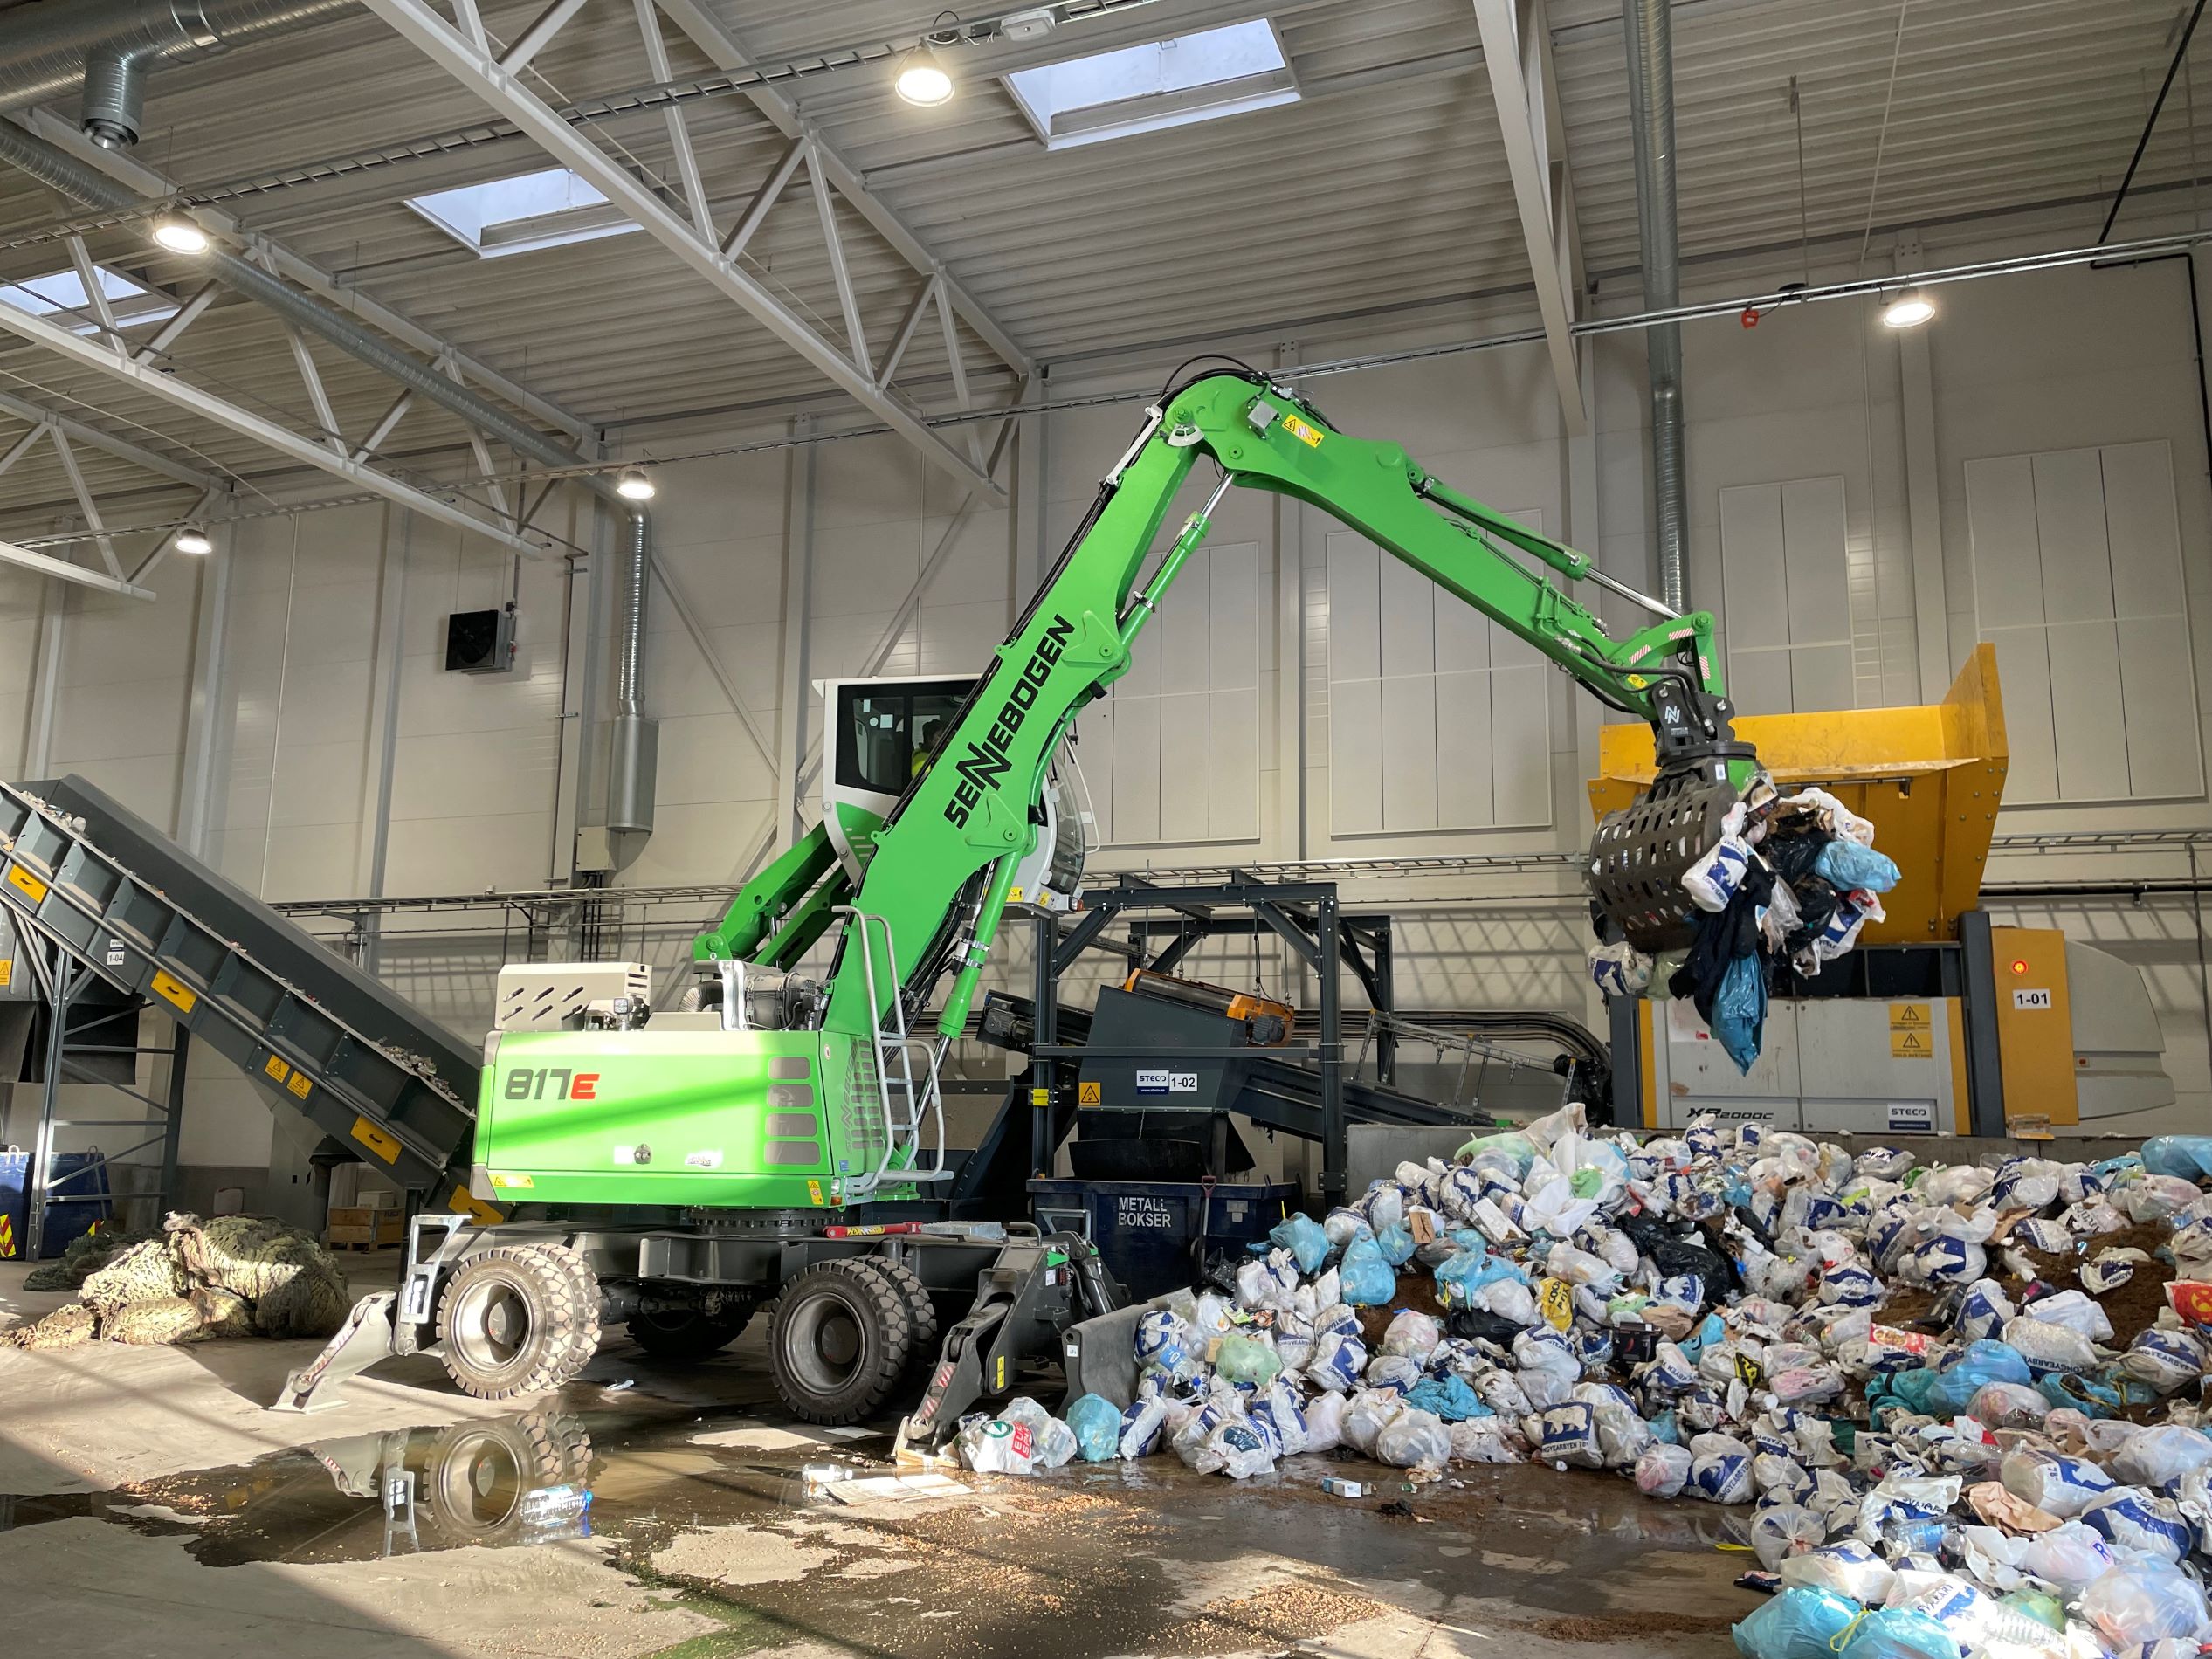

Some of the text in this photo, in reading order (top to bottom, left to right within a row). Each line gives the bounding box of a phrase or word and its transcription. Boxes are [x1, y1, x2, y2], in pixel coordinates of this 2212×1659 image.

[943, 613, 1075, 830] SENNEBOGEN
[108, 953, 123, 963] 1-04
[2016, 992, 2049, 1005] 1-01
[504, 1068, 601, 1100] 817E
[1171, 1077, 1196, 1088] 1-02
[1891, 1107, 1927, 1116] STECO
[1118, 1197, 1168, 1212] METALL
[1118, 1212, 1172, 1228] BOKSER
